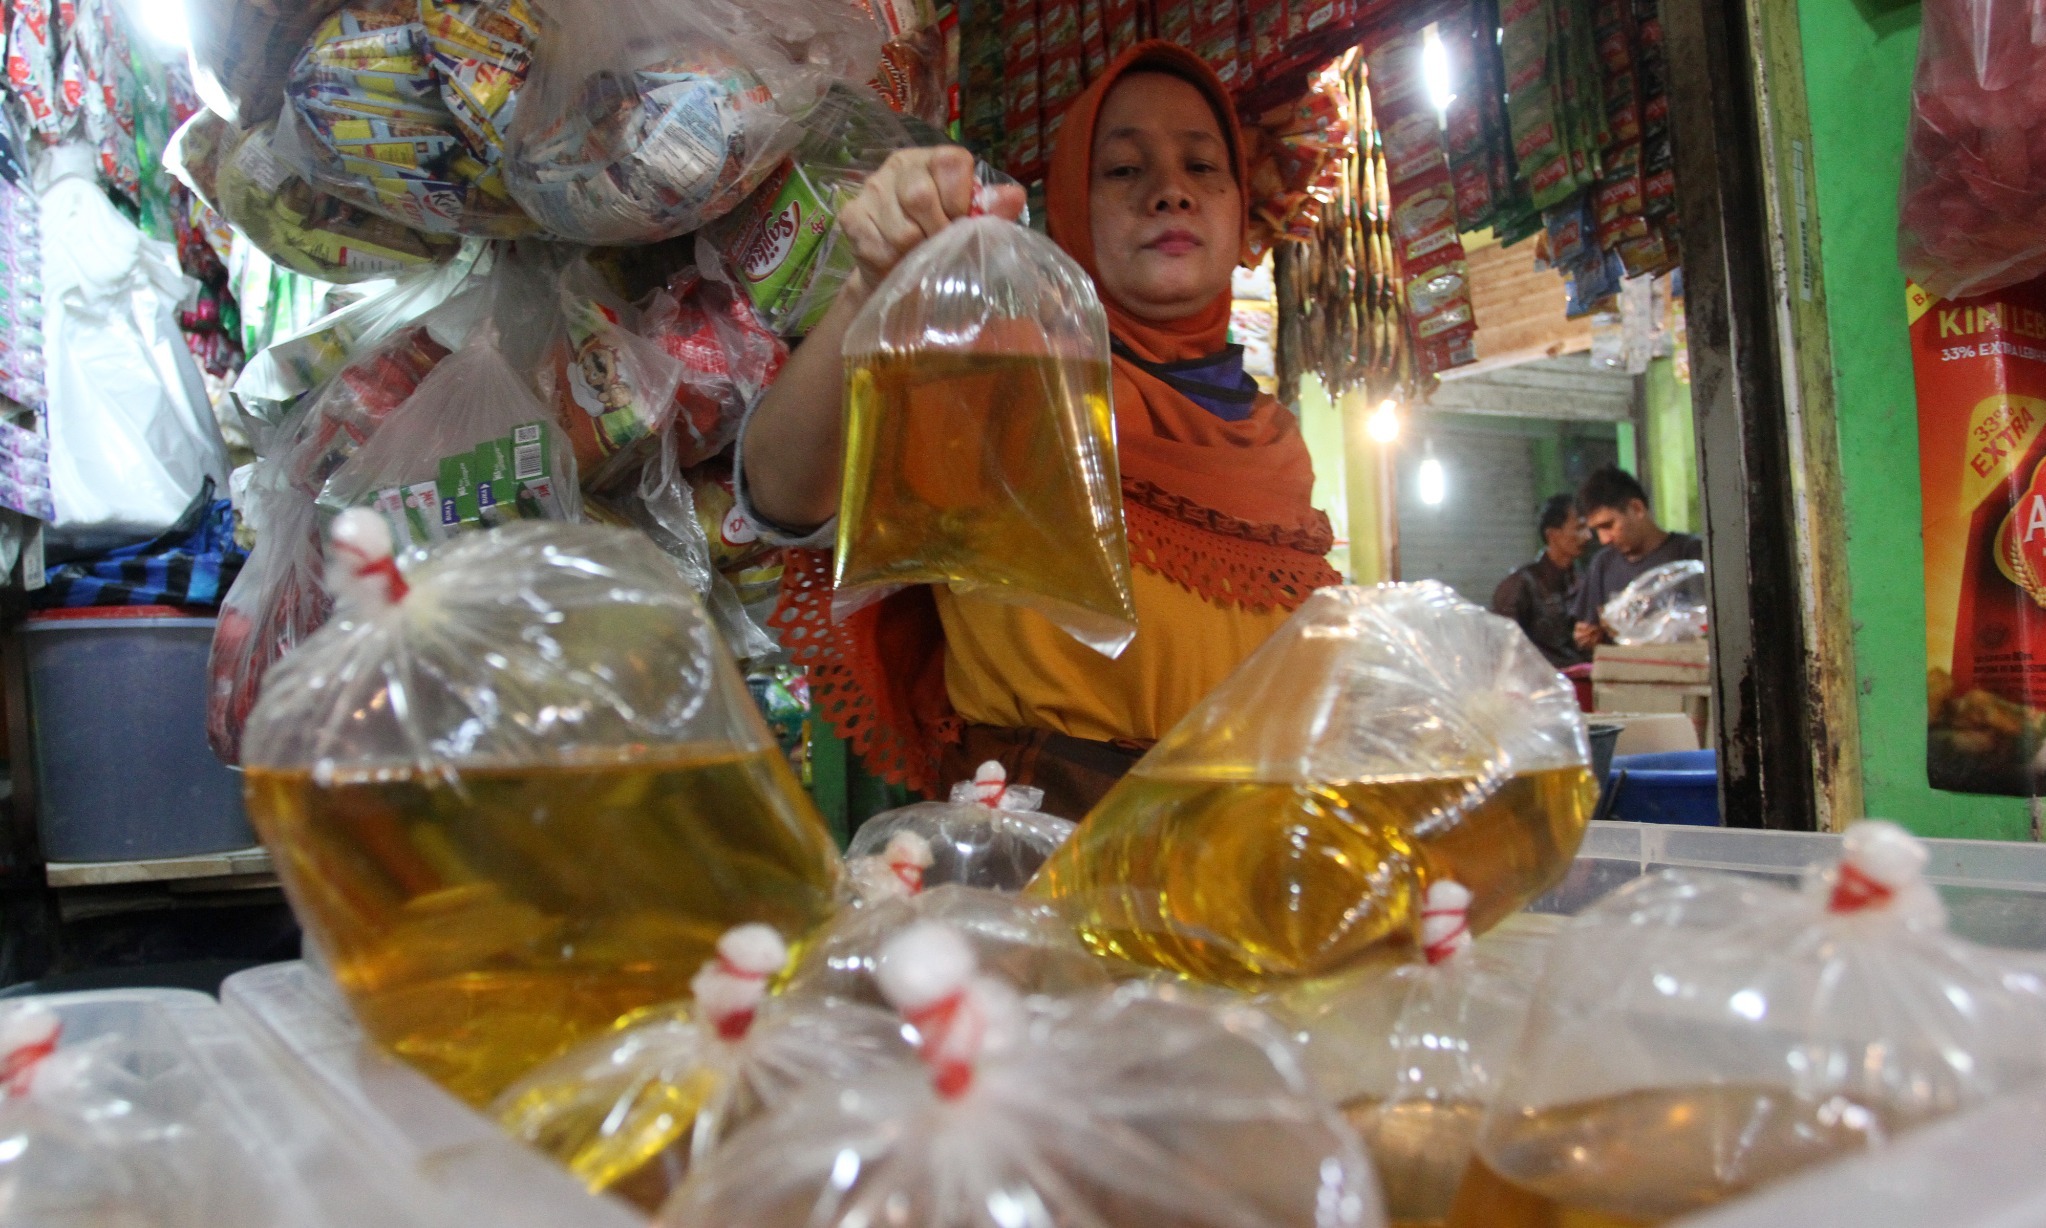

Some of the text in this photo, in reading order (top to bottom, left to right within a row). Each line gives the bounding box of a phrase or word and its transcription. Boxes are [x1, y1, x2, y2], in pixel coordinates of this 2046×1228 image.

[746, 210, 794, 274] Sajiku
[1940, 345, 1977, 362] 33%
[1969, 406, 2036, 479] EXTRA
[1973, 406, 2015, 442] 33%
